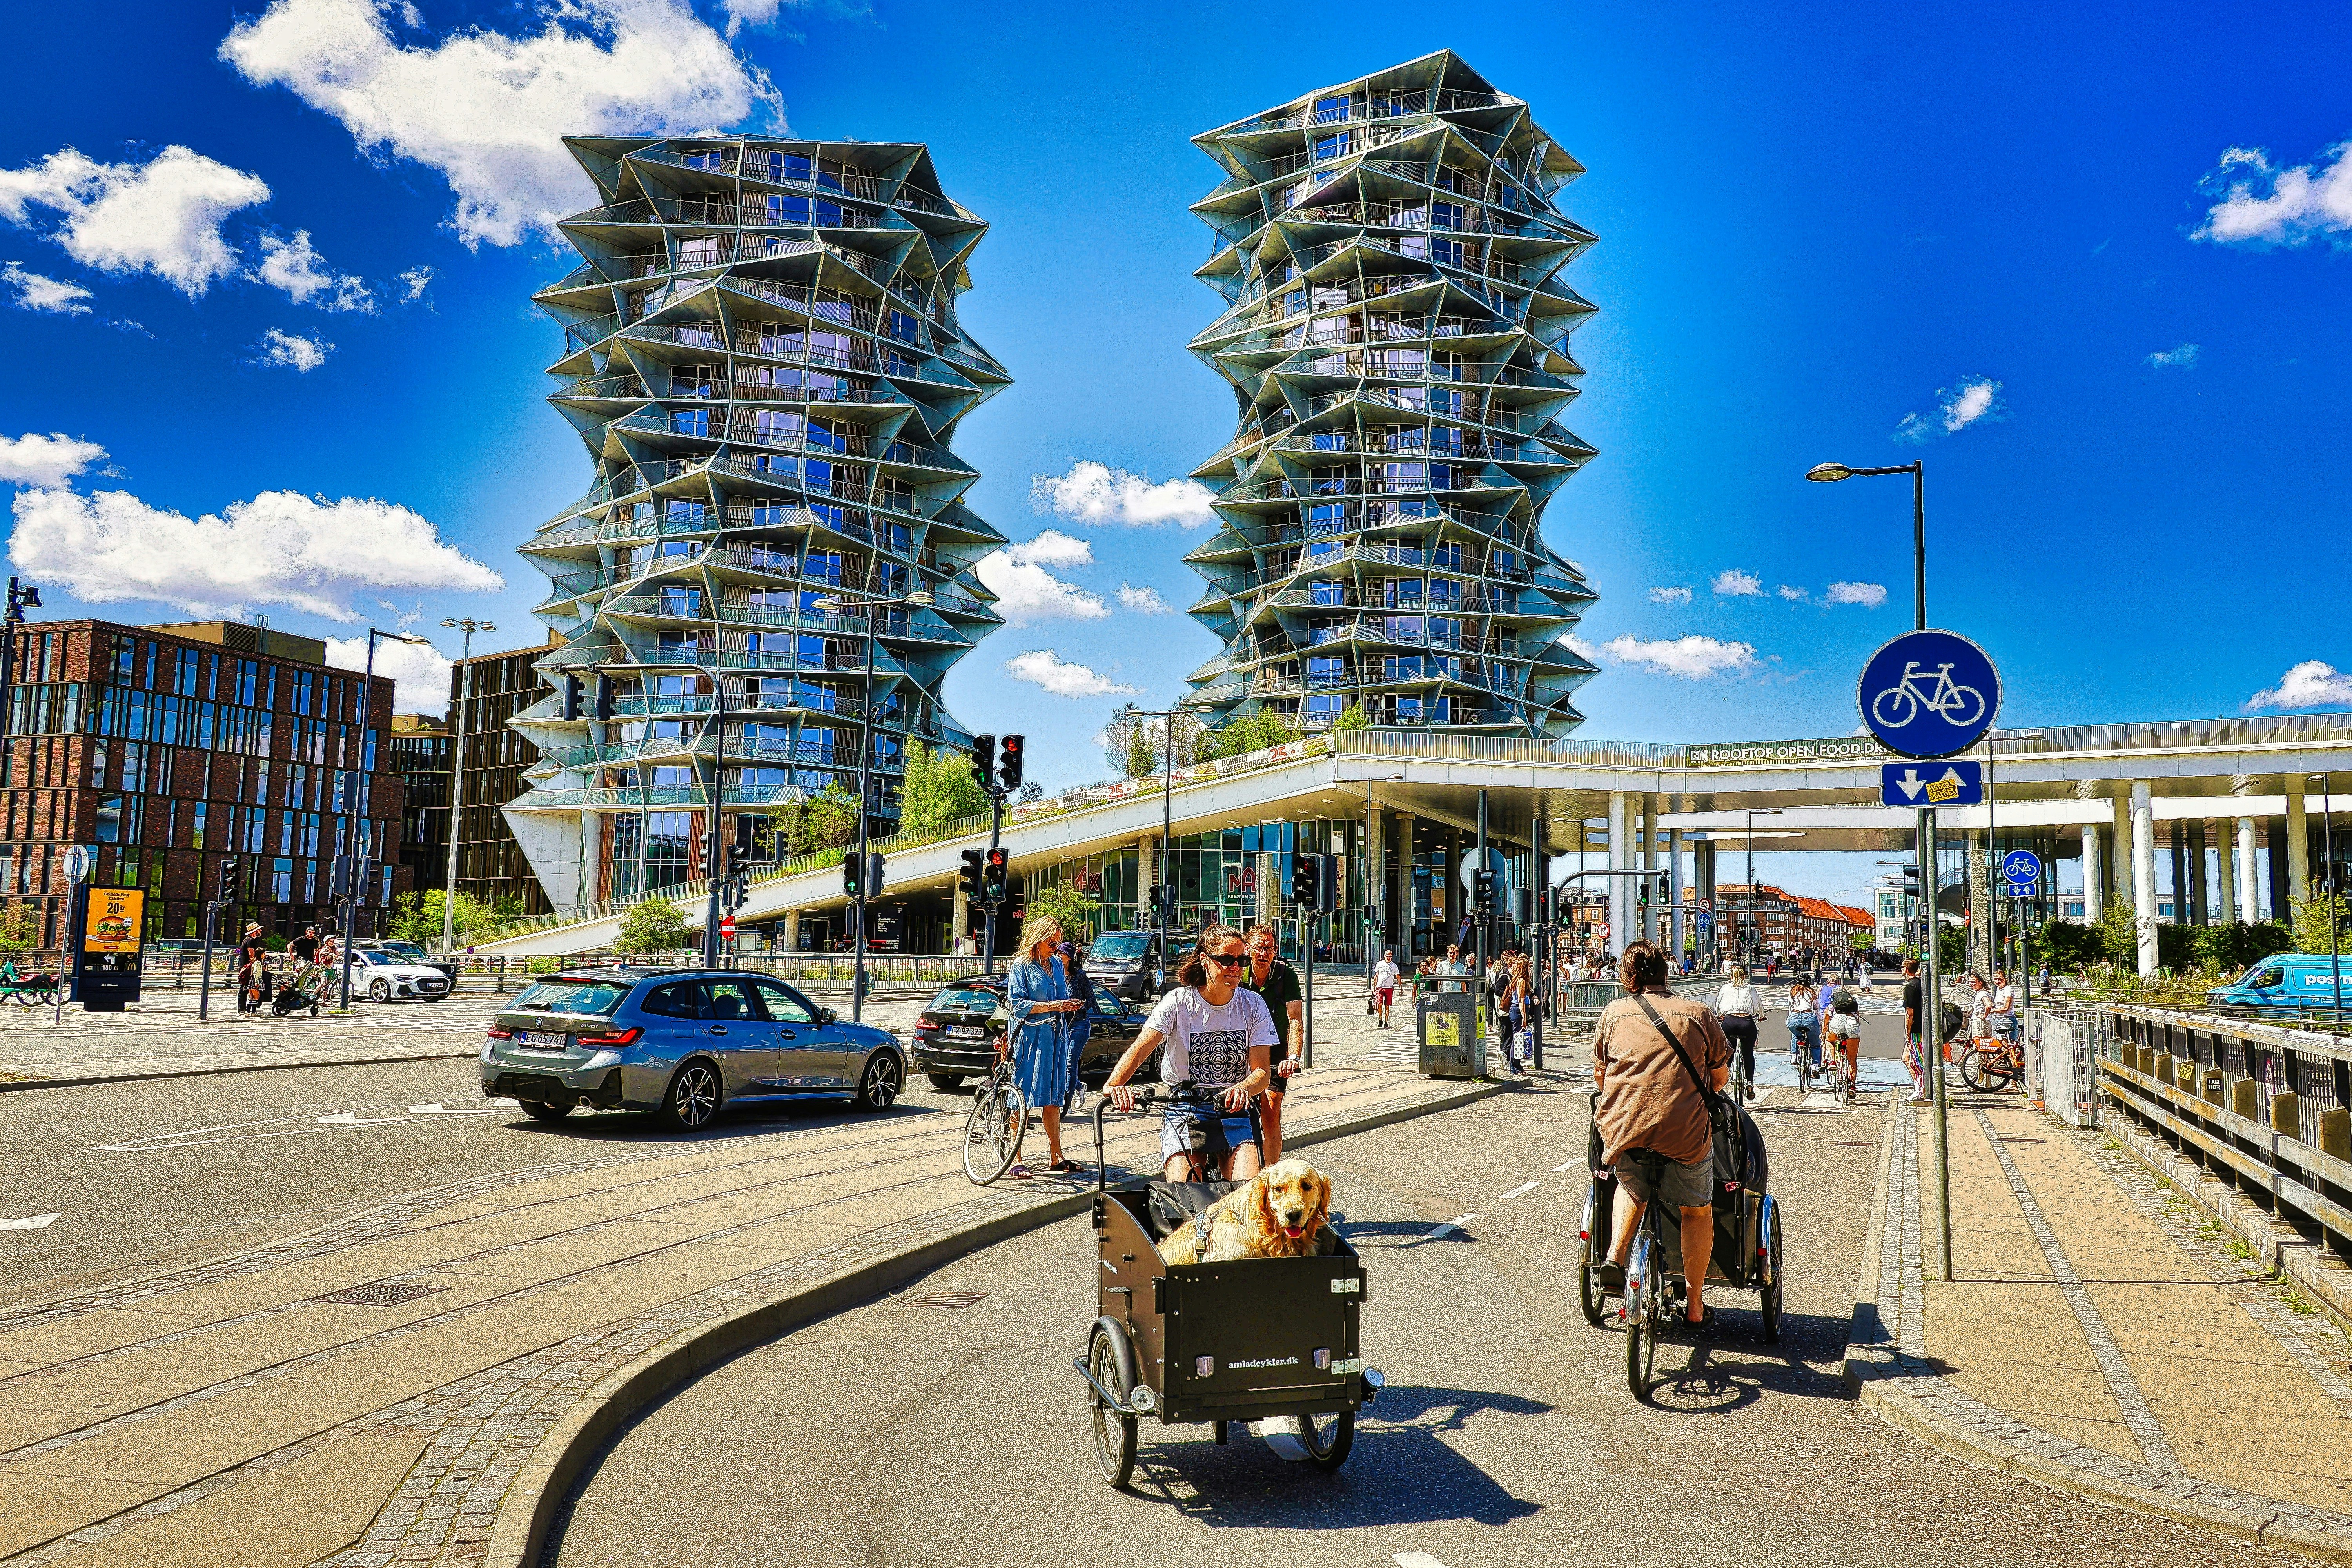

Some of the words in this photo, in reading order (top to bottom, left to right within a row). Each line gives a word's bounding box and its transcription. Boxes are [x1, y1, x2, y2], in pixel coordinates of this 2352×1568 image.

[1711, 747, 1773, 760] ROOFTOP
[1221, 755, 1249, 766] DOBBELT
[1223, 757, 1269, 773] CHEESEBURGER
[1063, 791, 1088, 804] DOBBELT
[1108, 784, 1131, 798] 25.-
[1229, 866, 1256, 893] MA
[107, 902, 120, 914] 20
[1228, 1356, 1299, 1368] amladcykler.dk
